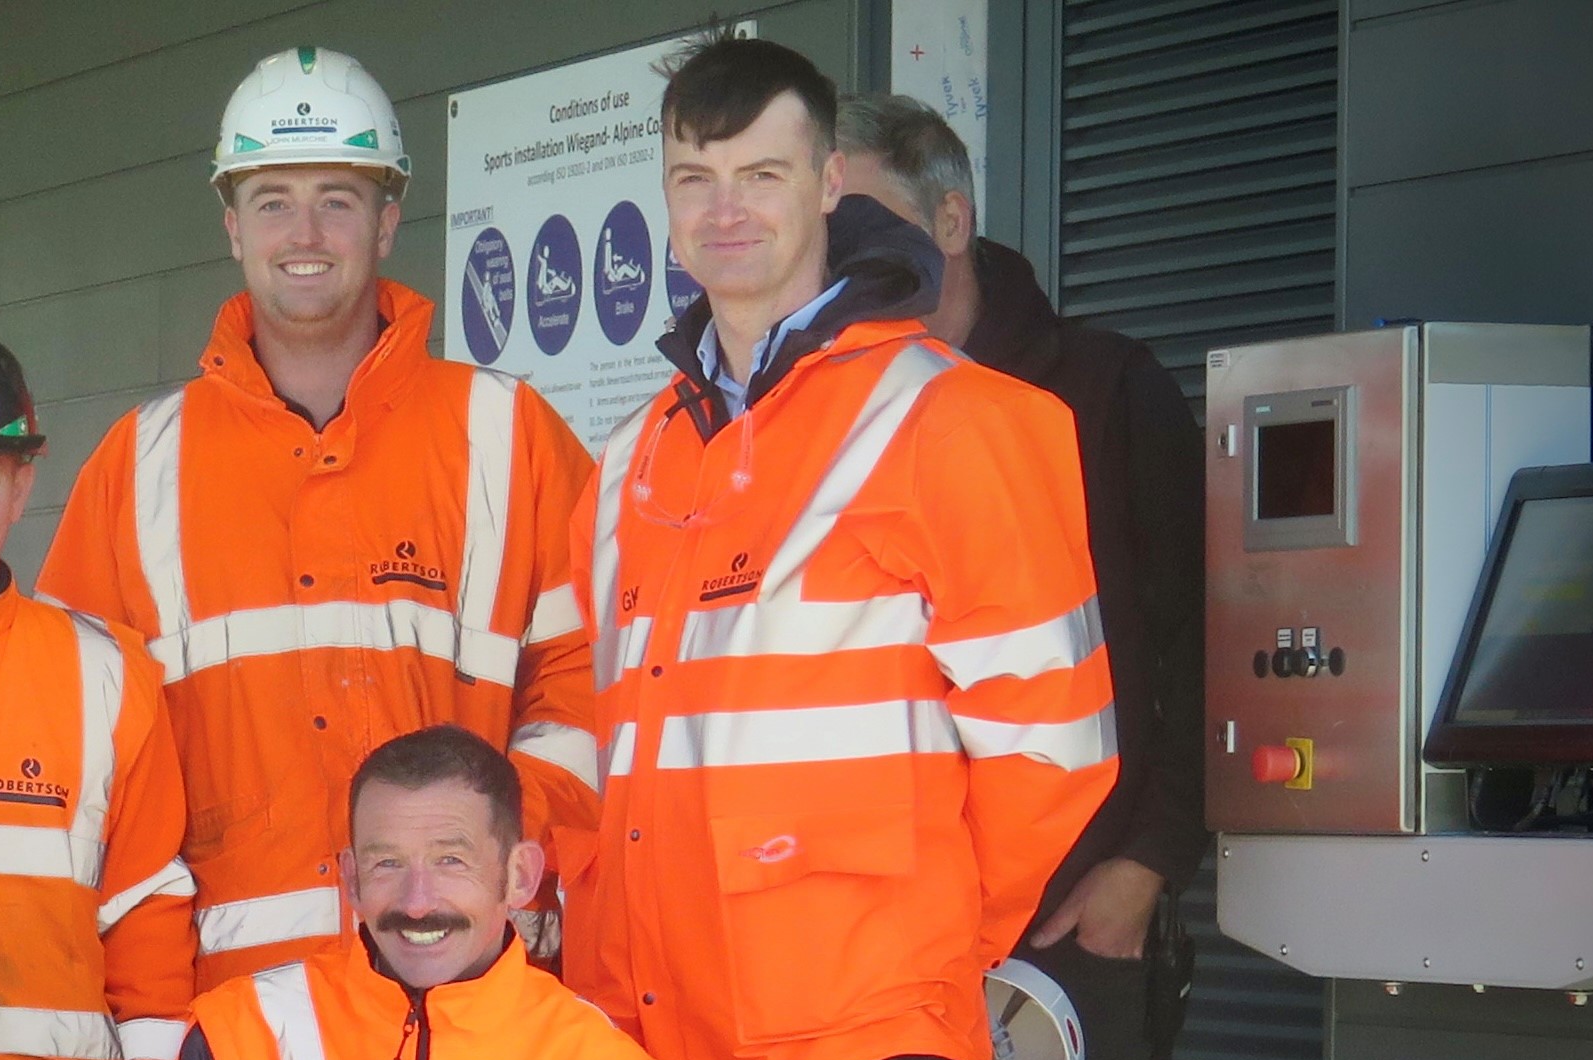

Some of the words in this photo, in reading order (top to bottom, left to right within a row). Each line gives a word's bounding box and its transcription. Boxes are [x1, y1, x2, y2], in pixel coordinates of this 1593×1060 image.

[549, 98, 599, 123] Conditions
[600, 90, 612, 111] of
[613, 91, 630, 108] use
[271, 117, 338, 127] ROBERTSON
[484, 150, 513, 175] Sports
[514, 138, 565, 167] installation
[566, 126, 611, 154] Wiegand-
[613, 121, 644, 145] Alpine
[450, 205, 494, 228] IMPORTANT!
